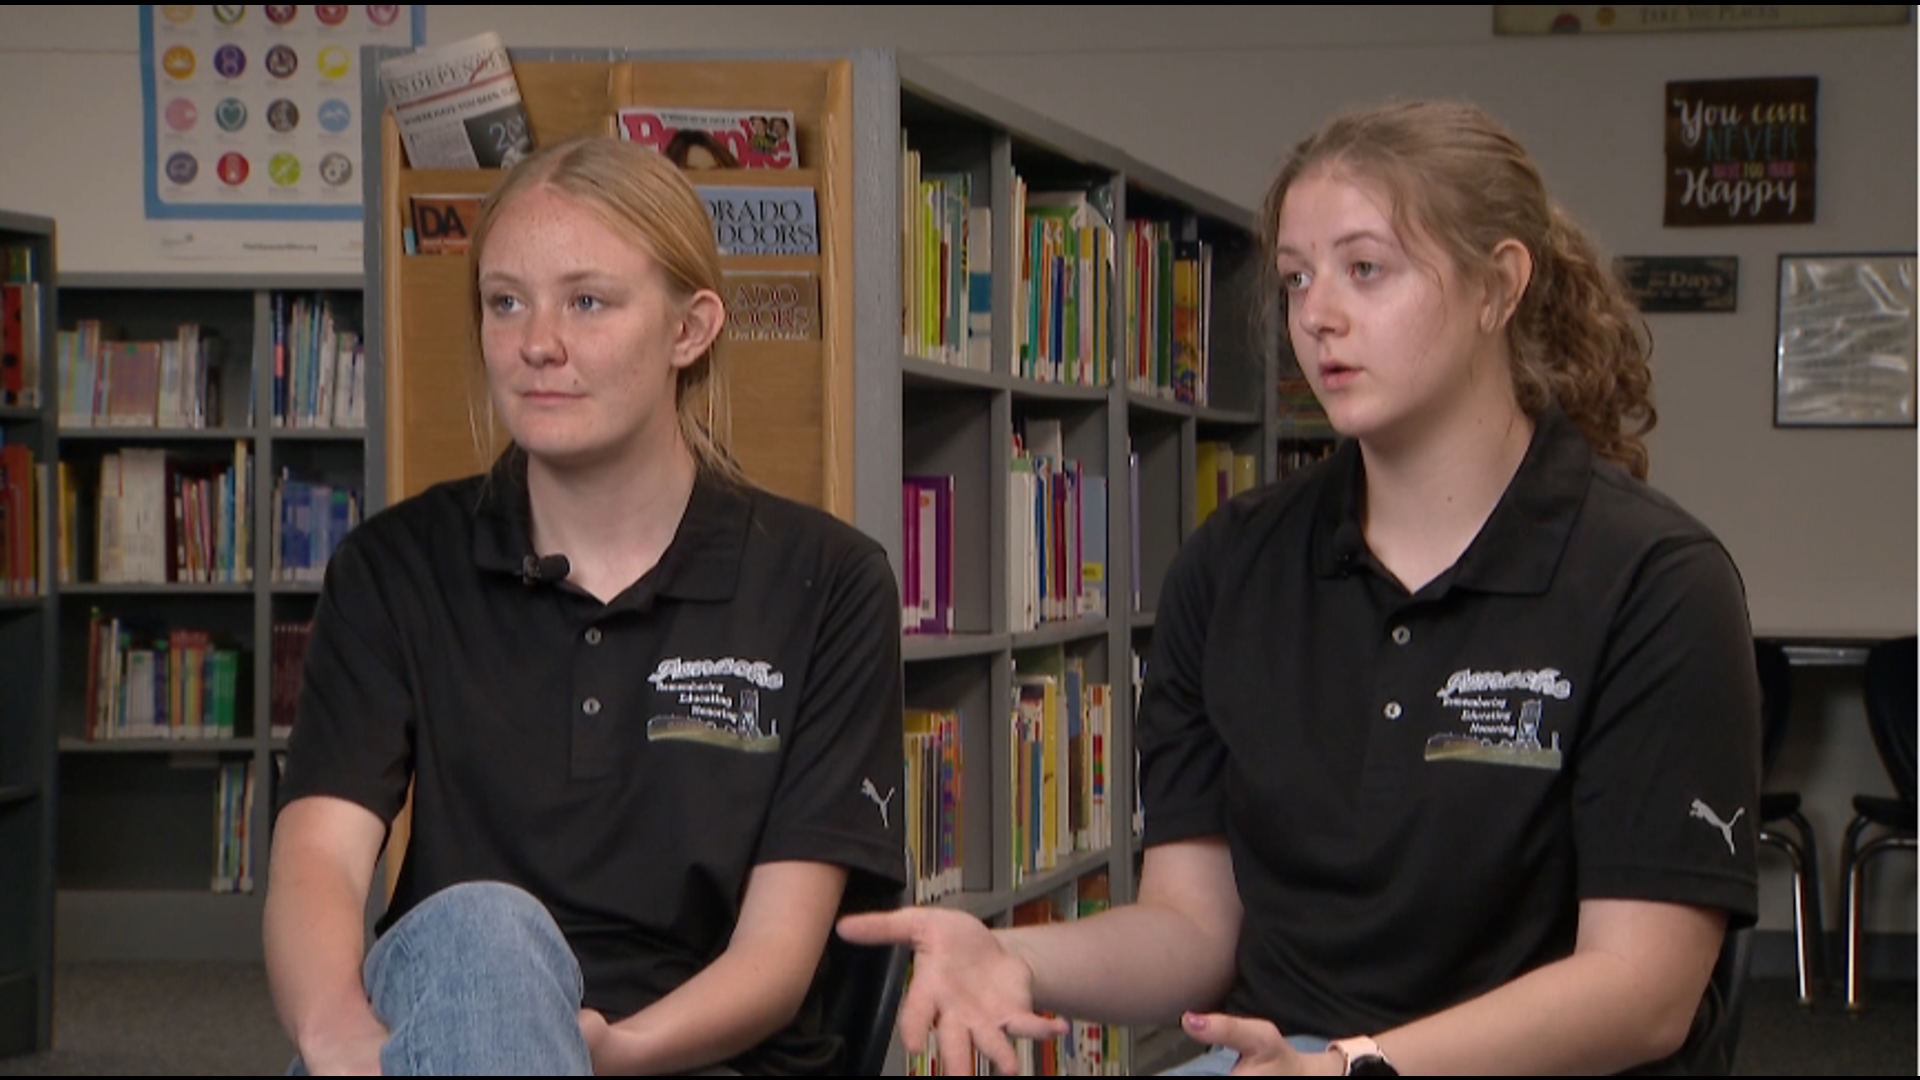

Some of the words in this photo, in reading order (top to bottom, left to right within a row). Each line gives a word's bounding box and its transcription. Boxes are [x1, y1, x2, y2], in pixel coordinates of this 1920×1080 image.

[1672, 97, 1744, 148] You
[1750, 101, 1808, 126] can
[1705, 124, 1800, 162] NEVER
[1675, 166, 1798, 218] Happy
[1668, 270, 1724, 293] Days
[656, 681, 724, 694] Remembering
[1442, 694, 1508, 709] Remembering
